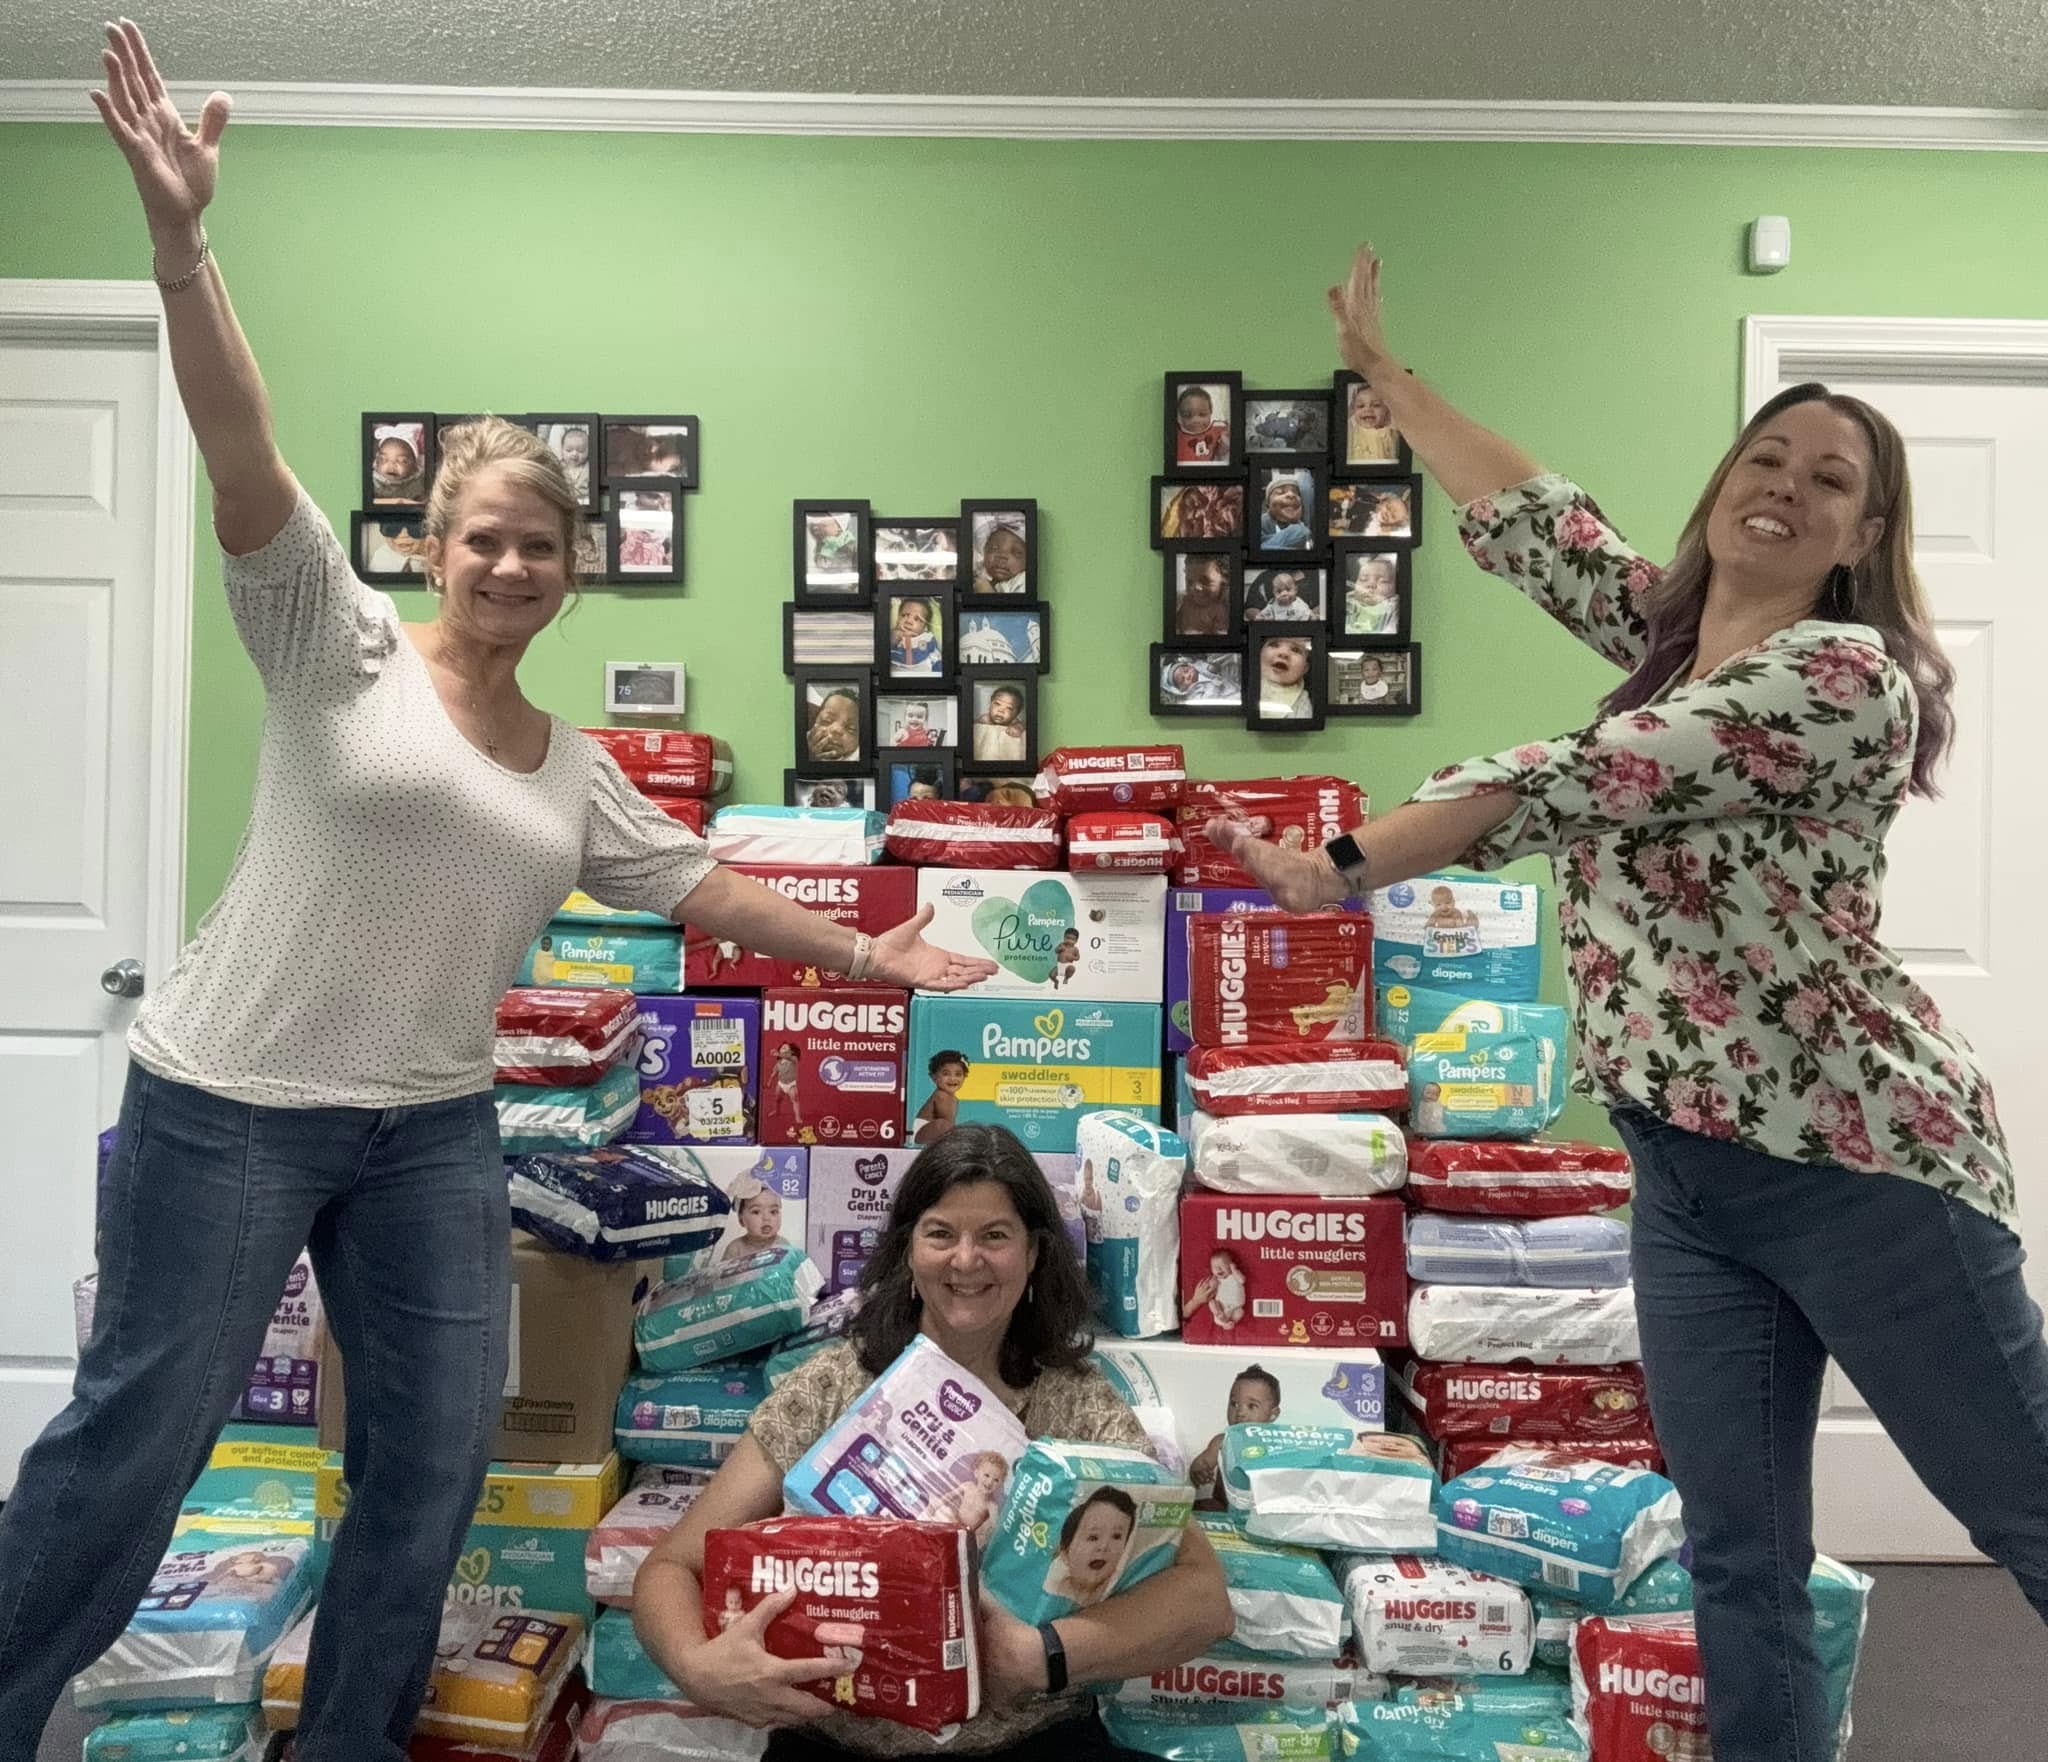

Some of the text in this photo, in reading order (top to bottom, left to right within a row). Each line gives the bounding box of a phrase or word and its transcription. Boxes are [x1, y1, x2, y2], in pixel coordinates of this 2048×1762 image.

[618, 685, 631, 695] 75
[1068, 757, 1125, 769] HUGGIES
[648, 774, 695, 785] HUGGIES
[1170, 783, 1177, 792] 3
[1114, 857, 1163, 867] HUGGIES
[749, 875, 860, 903] GGIES
[1400, 886, 1408, 896] 2
[1504, 892, 1519, 901] 40
[1028, 913, 1065, 928] Pampers
[993, 914, 1053, 951] Pure
[1338, 923, 1356, 936] 3
[561, 940, 616, 962] Pampers
[1251, 935, 1261, 959] little
[1262, 929, 1270, 965] movers
[1424, 940, 1478, 953] STEPS
[1004, 954, 1048, 962] protection
[1219, 919, 1249, 1044] HUGGIES
[1431, 968, 1473, 980] diapers
[763, 1000, 905, 1033] HUGGIES
[807, 1038, 897, 1052] little movers
[982, 1022, 1091, 1064] Pampers
[695, 1051, 741, 1065] A0002
[1001, 1069, 1070, 1081] swaddlers
[1438, 1058, 1506, 1082] Pampers
[1132, 1080, 1142, 1094] 3
[1512, 1086, 1524, 1096] N
[712, 1098, 723, 1115] 5
[1016, 1095, 1058, 1104] protection
[1256, 1096, 1300, 1106] Project Hug
[1512, 1108, 1524, 1116] 20
[700, 1116, 736, 1126] 03/23/24
[708, 1127, 732, 1136] 14:55
[879, 1119, 895, 1140] 6
[784, 1155, 798, 1172] 4
[782, 1179, 799, 1192] 82
[852, 1188, 889, 1202] Dry &
[1487, 1190, 1511, 1199] Project
[645, 1195, 709, 1221] HUGGIES
[848, 1200, 893, 1211] Gentle
[1216, 1209, 1366, 1242] HUGGIES
[1260, 1247, 1366, 1263] little snugglers
[279, 1301, 306, 1315] ry &
[272, 1313, 310, 1326] entle
[1379, 1320, 1397, 1337] n
[1487, 1339, 1533, 1349] Project Hug
[1361, 1373, 1376, 1392] 3
[1446, 1379, 1542, 1401] HUGGIES
[269, 1391, 284, 1410] 3
[1354, 1399, 1381, 1414] 100
[703, 1416, 745, 1428] diapers
[915, 1401, 955, 1445] Dry &
[901, 1410, 948, 1460] Gentle
[1245, 1426, 1346, 1441] Pampers
[231, 1446, 331, 1461] our softest comfort
[242, 1456, 318, 1468] and protection
[1499, 1479, 1559, 1497] diapers
[1003, 1472, 1033, 1534] baby-dry
[1013, 1472, 1053, 1556] Pampers
[1532, 1529, 1579, 1553] diapers
[752, 1555, 880, 1599] HUGGIES
[447, 1583, 524, 1607] pers
[806, 1604, 880, 1622] little snugglers
[947, 1592, 957, 1639] HUGGIES
[1384, 1599, 1477, 1620] HUGGIES
[1384, 1622, 1443, 1634] snug & dry
[1499, 1650, 1513, 1671] 6
[1151, 1665, 1285, 1699] HUGGIES
[905, 1678, 918, 1707] 1
[1630, 1702, 1655, 1718] little
[1299, 1734, 1321, 1751] dry
